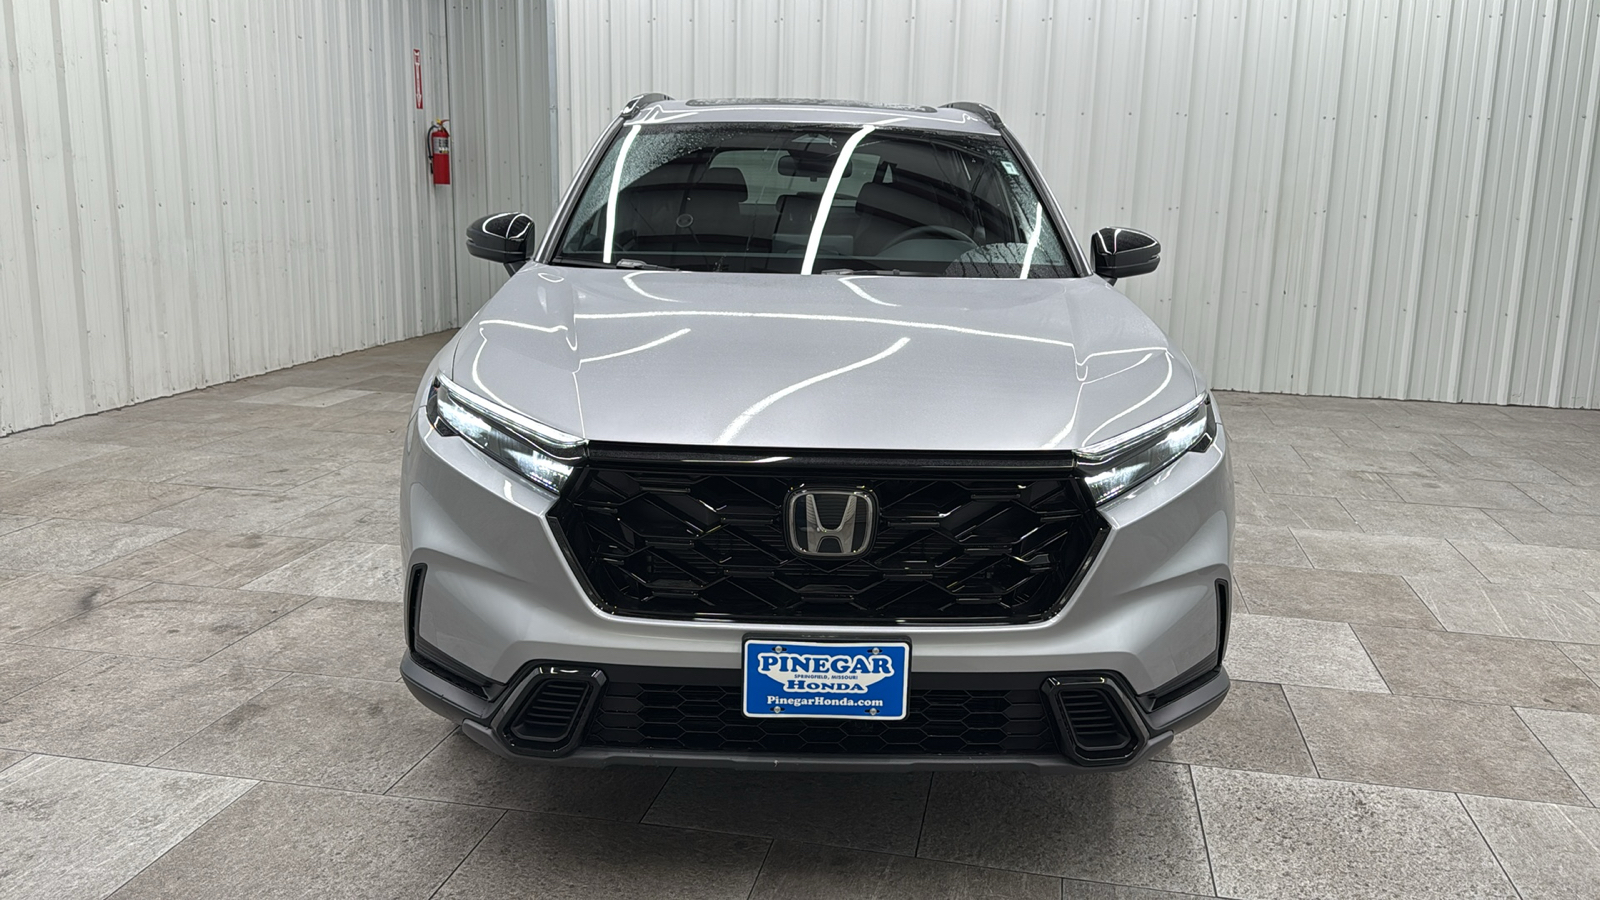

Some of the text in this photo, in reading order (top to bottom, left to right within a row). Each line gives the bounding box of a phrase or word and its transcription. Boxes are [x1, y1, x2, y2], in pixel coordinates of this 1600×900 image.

[760, 655, 893, 674] PINEGAR
[787, 679, 866, 691] HONDA
[766, 695, 884, 707] PinegarHonda.com
